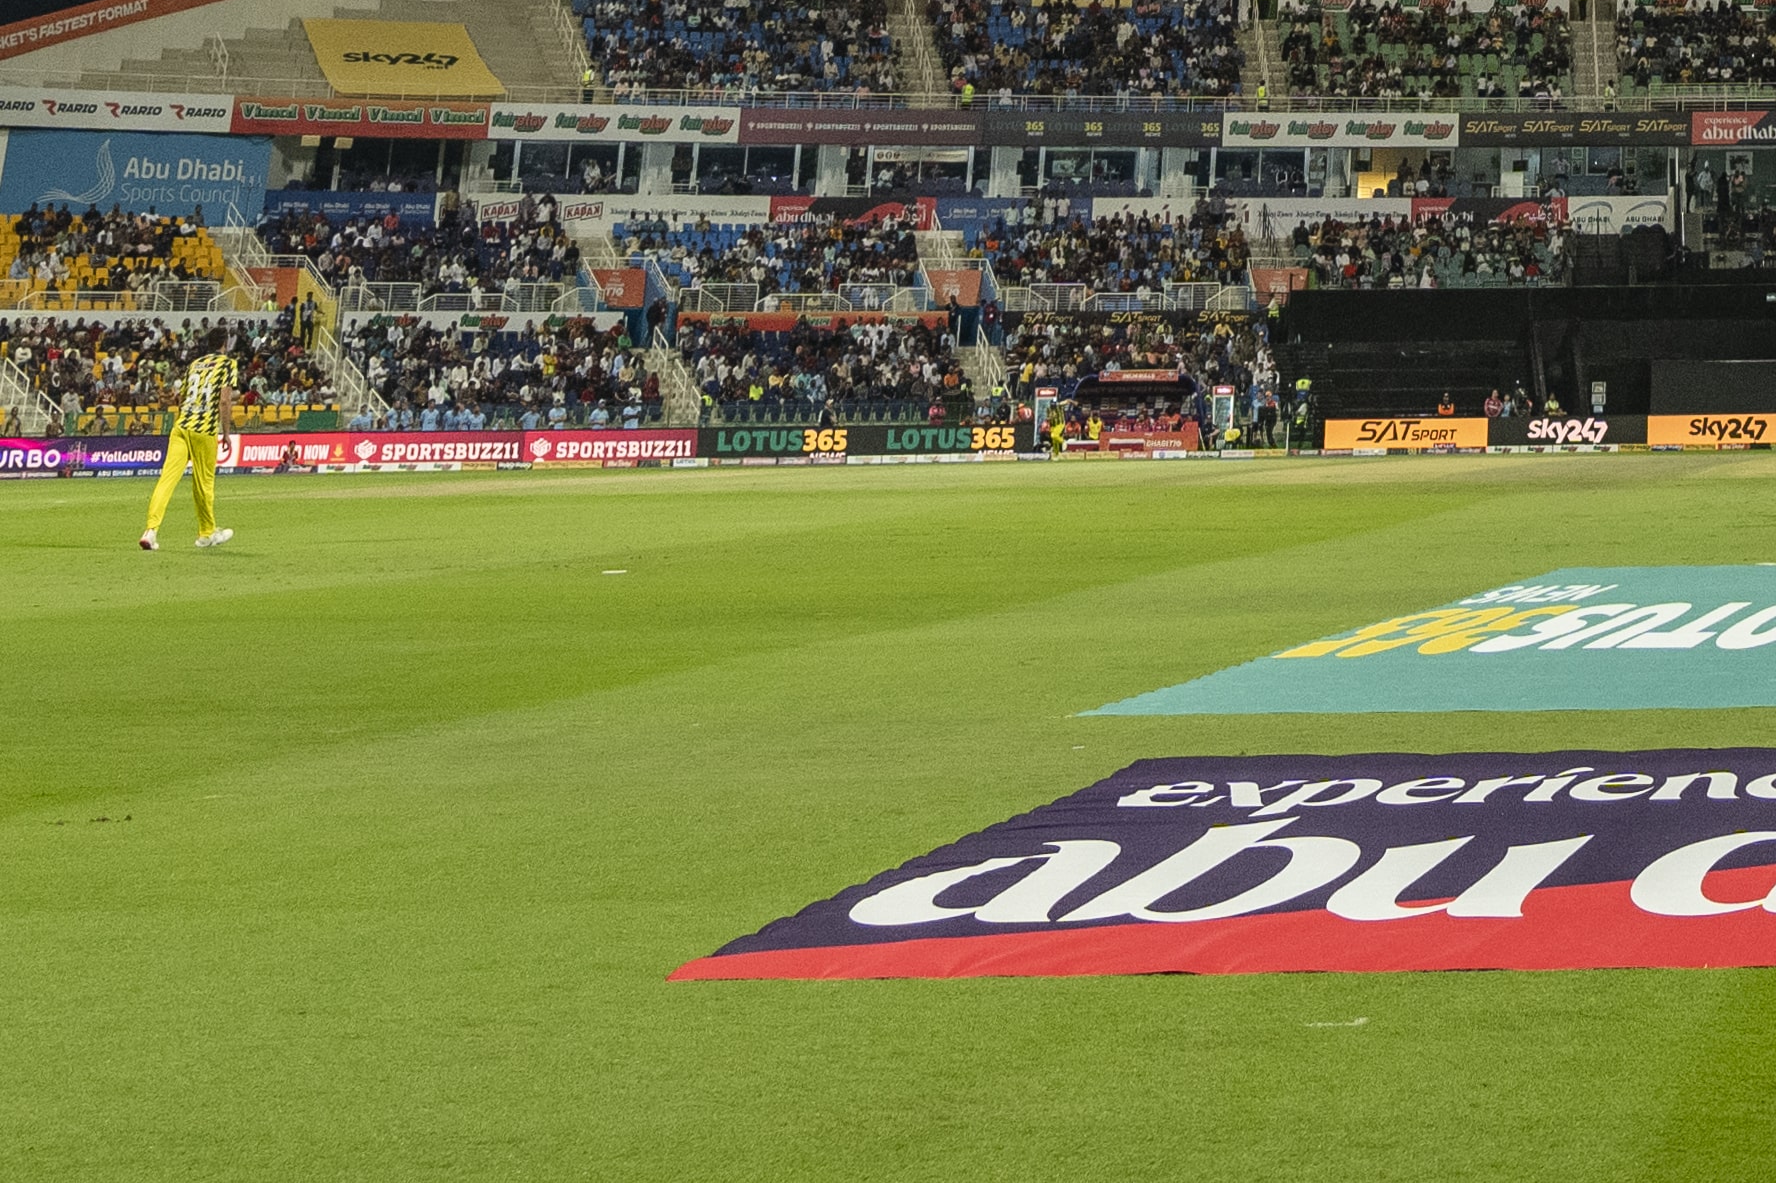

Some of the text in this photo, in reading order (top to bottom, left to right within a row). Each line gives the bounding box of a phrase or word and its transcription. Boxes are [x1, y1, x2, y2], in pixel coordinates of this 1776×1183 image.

[39, 11, 97, 39] FASTEST
[57, 103, 97, 114] RARIO
[121, 105, 162, 117] RARIO
[186, 107, 226, 119] RARIO
[1704, 117, 1748, 126] experience
[1703, 125, 1733, 140] abu
[123, 157, 243, 182] Abu Dhabi
[120, 183, 239, 204] Sports Council
[776, 211, 799, 223] abu
[556, 439, 691, 458] SPORTSBUZZ11
[716, 429, 848, 452] LOTUS365
[886, 428, 1015, 450] LOTUS365
[91, 451, 161, 463] #YallaURBO
[304, 445, 330, 460] NOW
[381, 442, 519, 461] SPORTSBUZZ11
[1461, 582, 1619, 606] NEWS
[846, 815, 1596, 927] abu
